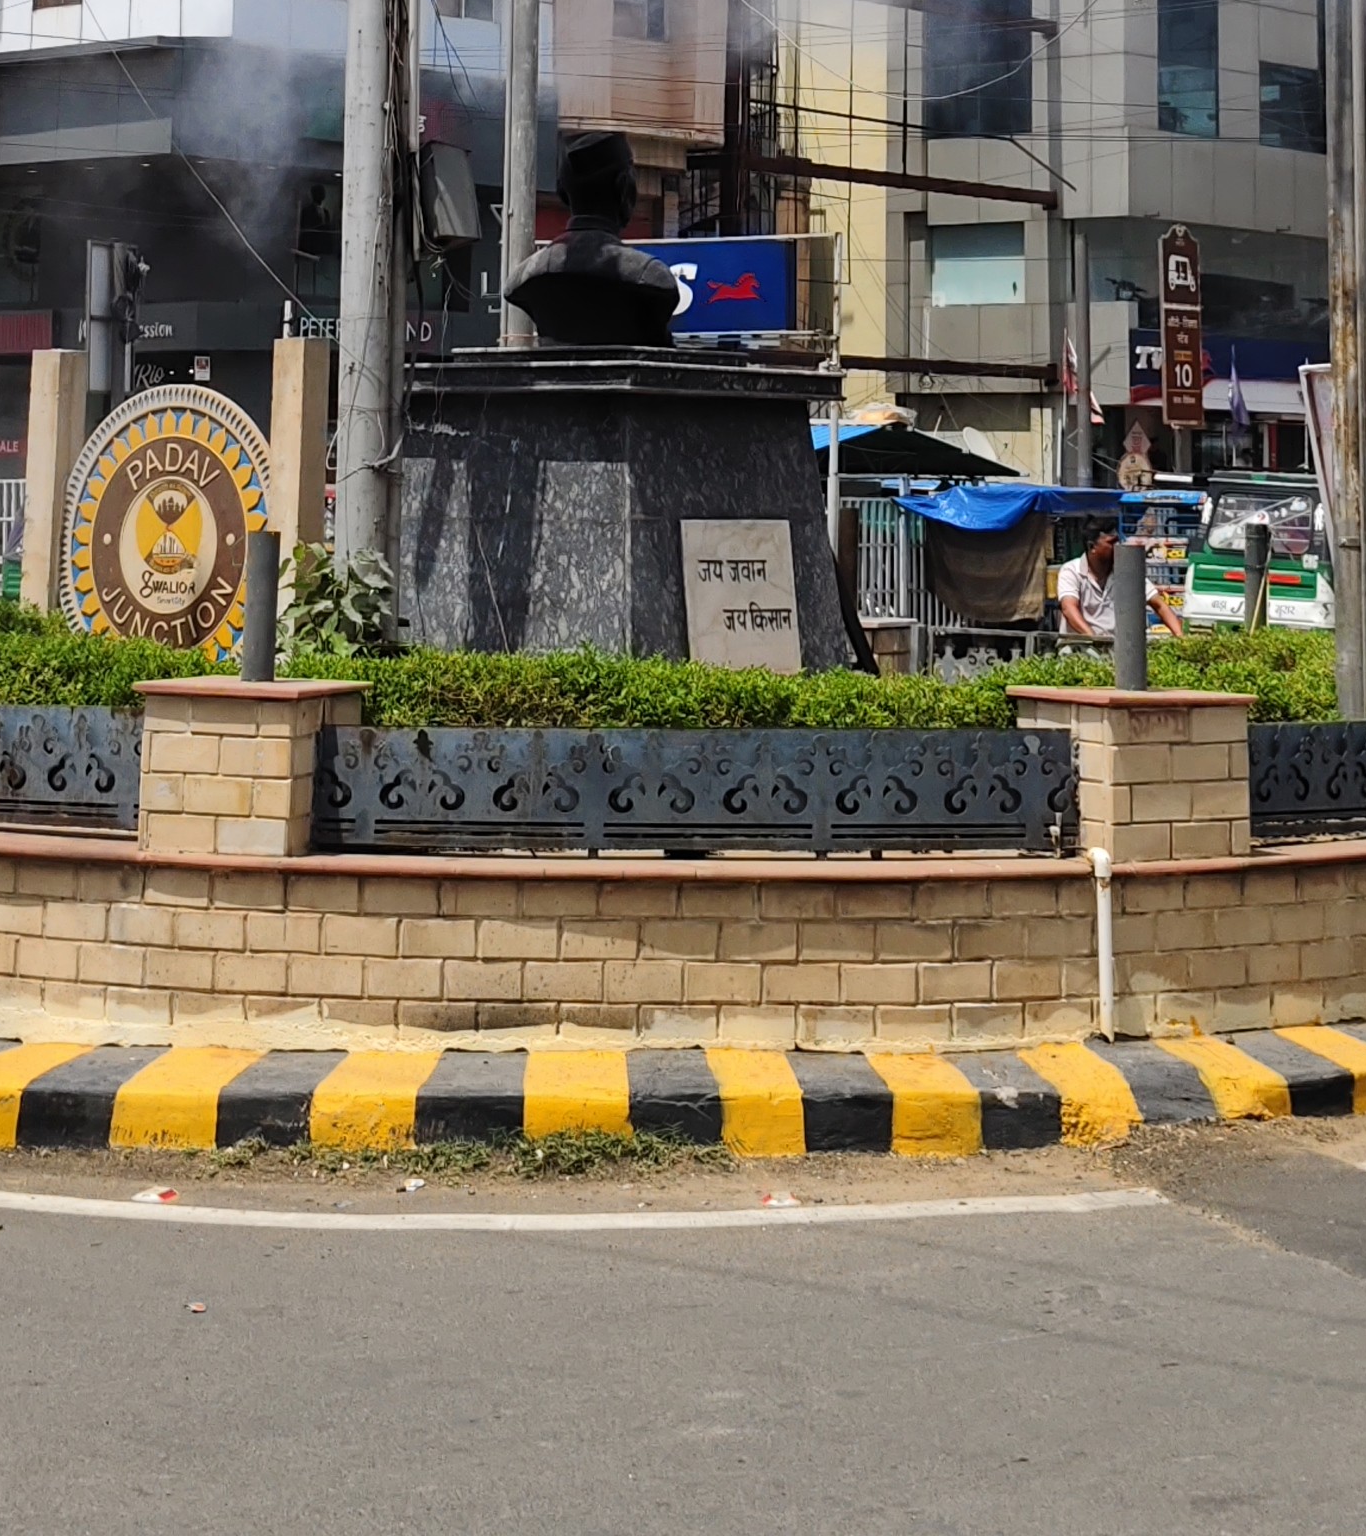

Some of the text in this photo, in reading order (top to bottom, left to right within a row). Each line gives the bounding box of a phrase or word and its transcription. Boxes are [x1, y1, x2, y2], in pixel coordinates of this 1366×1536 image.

[299, 317, 341, 338] PETER
[1175, 363, 1193, 387] 10
[125, 442, 221, 491] PADAV
[698, 560, 767, 583] जय जवान
[102, 576, 234, 646] JUNCTION
[723, 601, 792, 632] जय किसान
